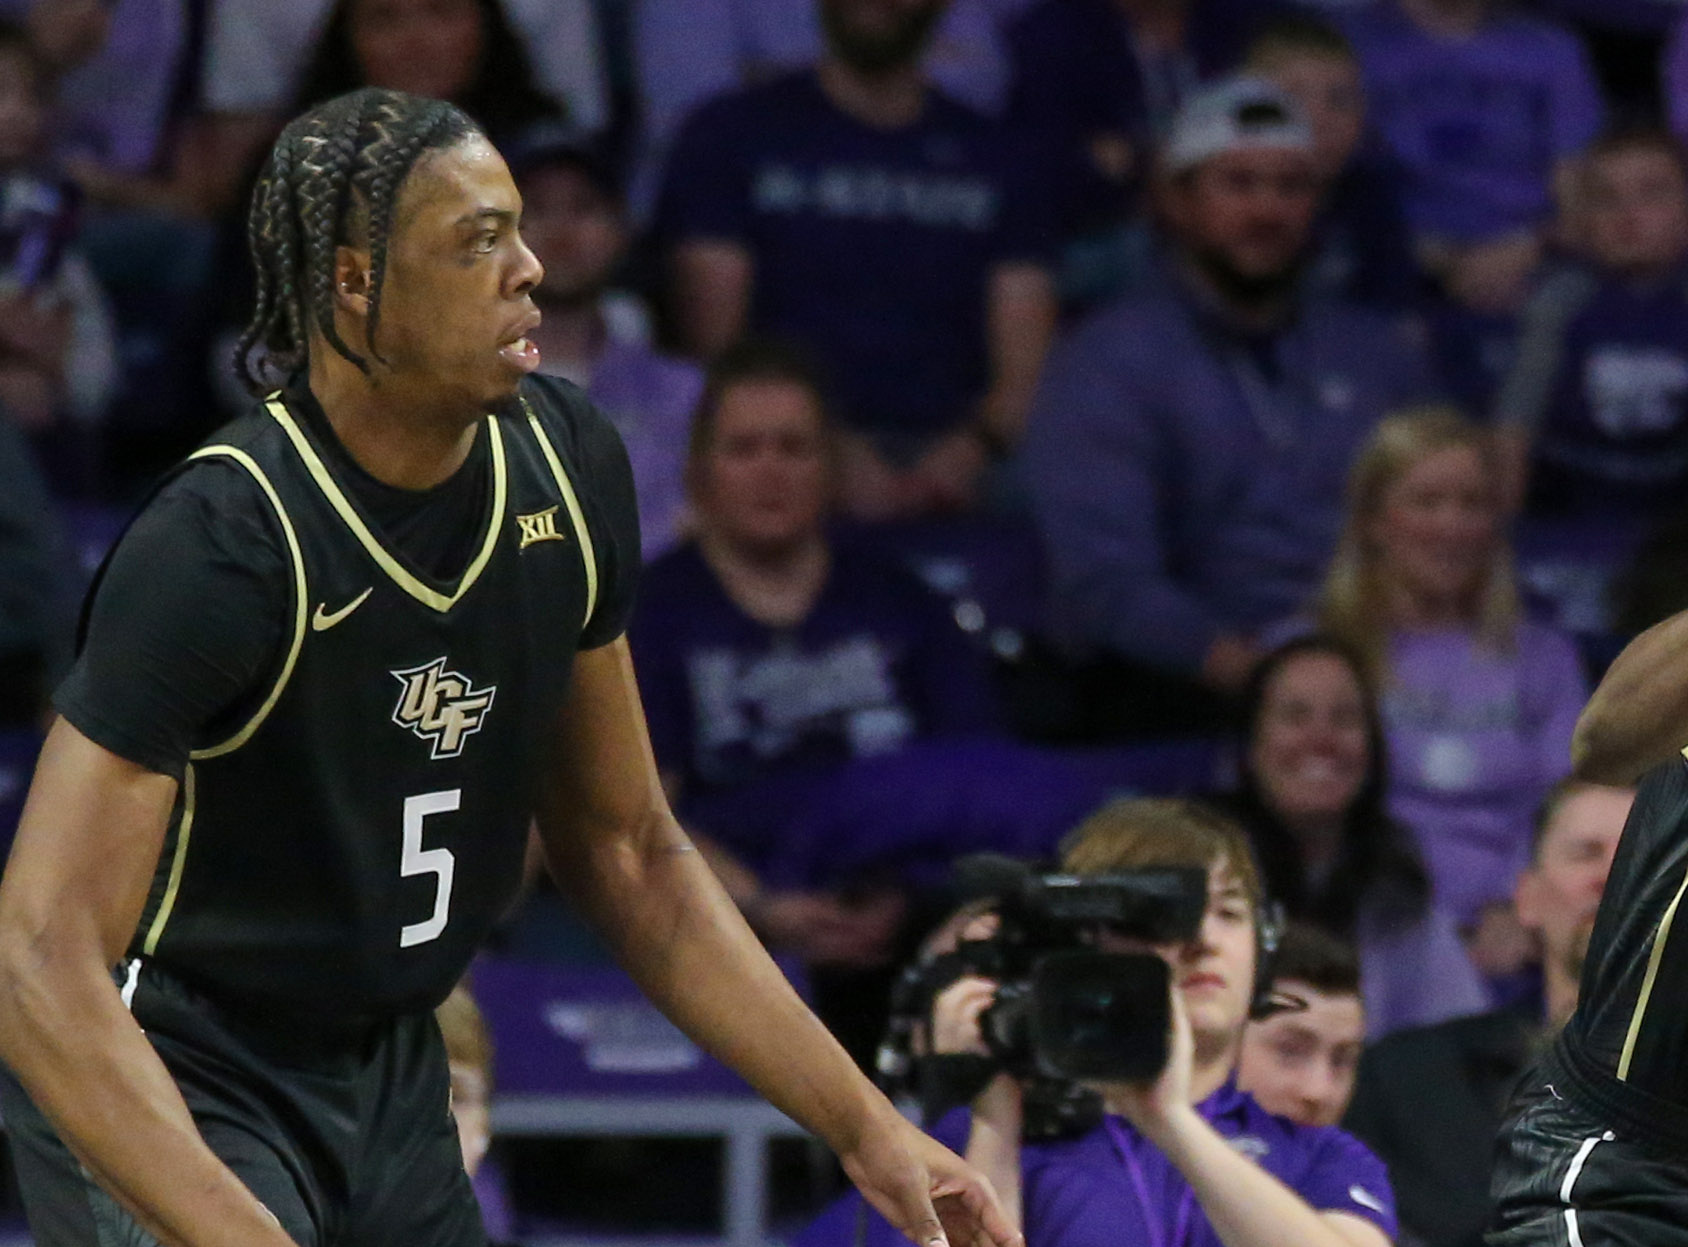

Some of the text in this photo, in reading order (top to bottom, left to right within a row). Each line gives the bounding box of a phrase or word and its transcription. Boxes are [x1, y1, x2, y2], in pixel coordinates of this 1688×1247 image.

[516, 505, 564, 549] XII
[392, 658, 496, 759] UCF
[400, 788, 462, 949] 5
